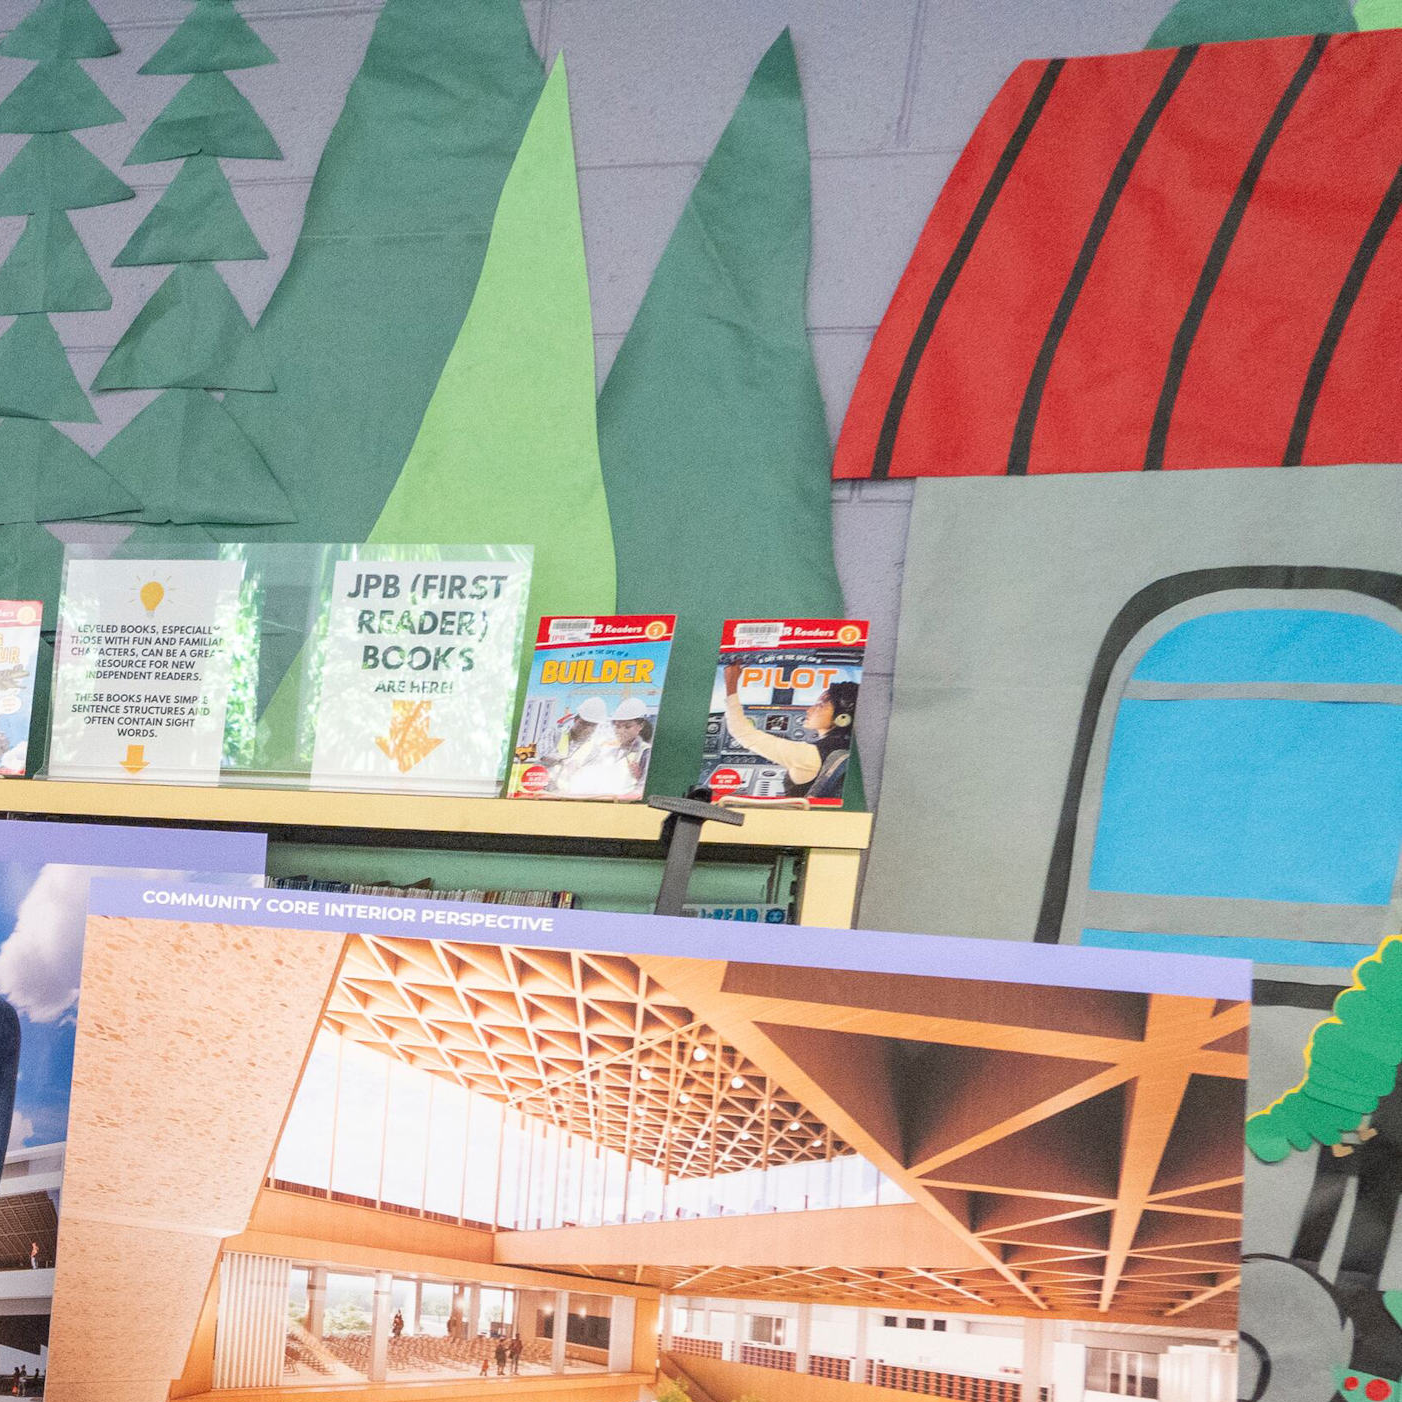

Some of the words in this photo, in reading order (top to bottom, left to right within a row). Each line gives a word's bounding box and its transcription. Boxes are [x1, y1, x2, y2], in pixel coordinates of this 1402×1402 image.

[347, 573, 401, 599] JPB
[410, 574, 508, 605] (FIRST
[77, 624, 118, 634] LEVELED
[120, 625, 159, 635] BOOKS,
[357, 610, 489, 642] READER)
[604, 624, 643, 634] Readers
[794, 627, 835, 637] Readers
[104, 636, 130, 645] WITH
[132, 637, 152, 645] FUN
[154, 637, 176, 646] AND
[71, 647, 139, 658] CHAACTERS,
[141, 648, 164, 657] CAN
[166, 649, 178, 657] BE
[179, 649, 187, 657] A
[95, 659, 147, 668] RESOURCE
[149, 660, 169, 669] FOR
[172, 661, 195, 669] NEW
[361, 645, 475, 672] BOOKS
[86, 671, 152, 680] INDEPENDENT
[154, 672, 202, 681] READERS.
[540, 659, 655, 684] BUILDER
[742, 667, 839, 690] PILOT
[375, 680, 406, 693] ARE
[76, 693, 104, 702] THESE
[106, 694, 142, 703] BOOKS
[144, 695, 171, 703] HAVE
[173, 695, 208, 704] SIMPE
[72, 705, 120, 713] SENTENCE
[123, 706, 185, 715] STRUCTURES
[84, 716, 114, 725] OFTEN
[117, 717, 163, 726] CONTAIN
[165, 718, 195, 727] SIGHT
[117, 729, 158, 738] WORDS.
[142, 890, 261, 911] COMMUNITY
[266, 899, 319, 915] CORE
[325, 902, 416, 922] INTERIOR
[421, 909, 554, 932] PERSPECTIVE
